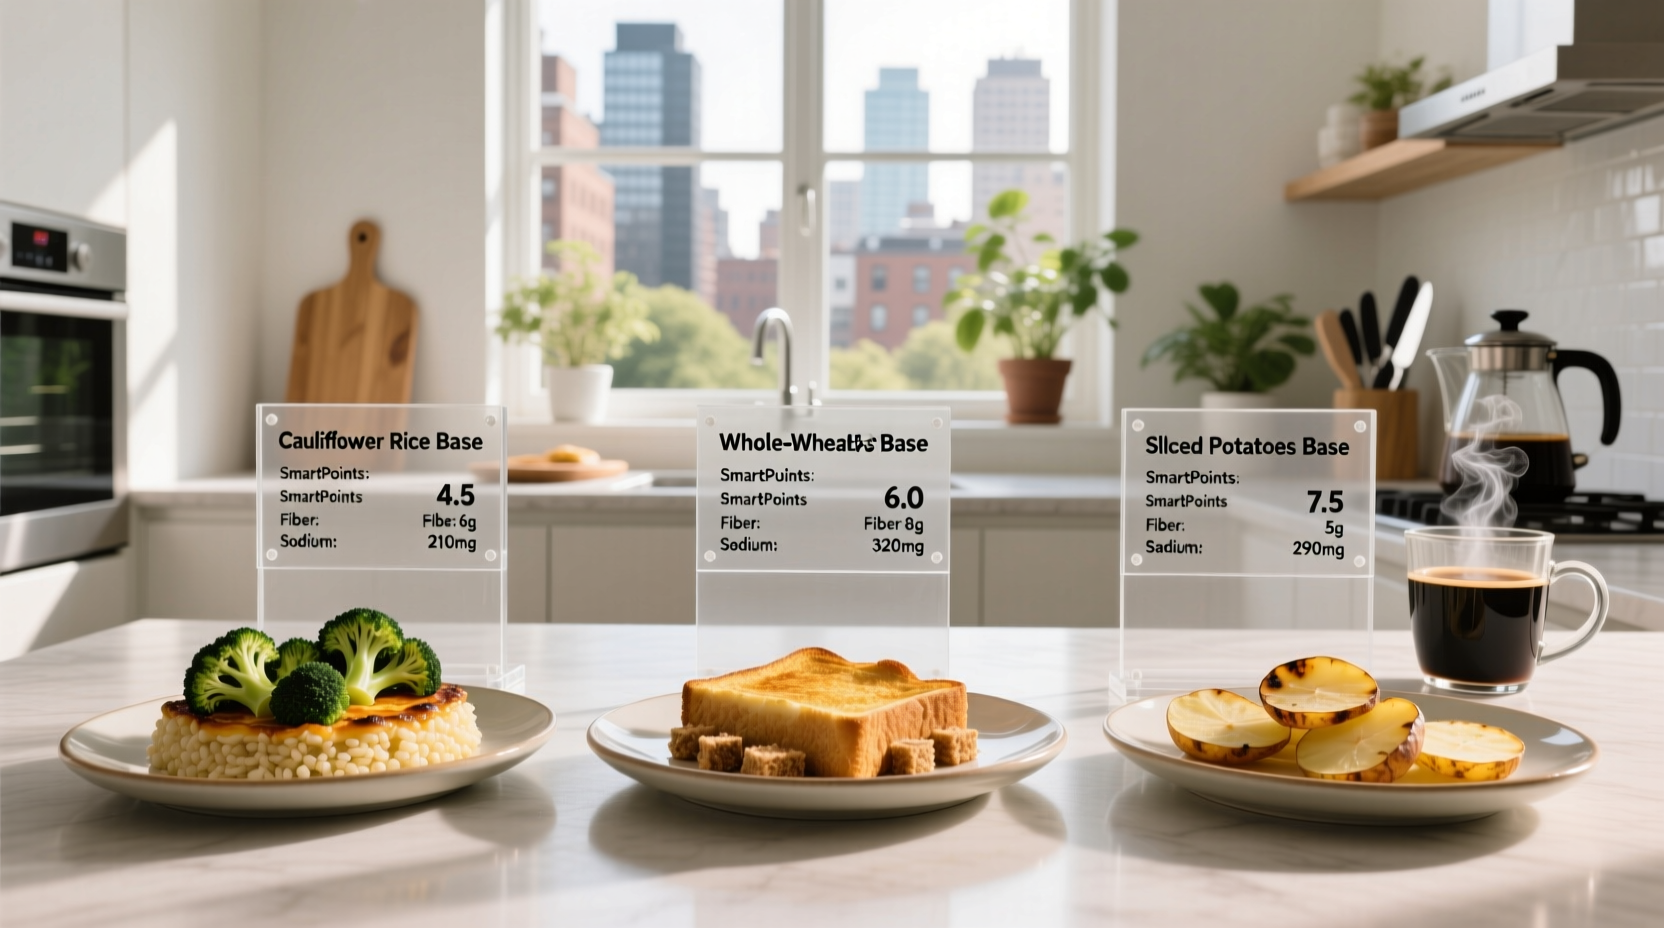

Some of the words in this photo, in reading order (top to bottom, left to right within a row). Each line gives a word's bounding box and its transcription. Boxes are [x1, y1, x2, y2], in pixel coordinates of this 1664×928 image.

[390, 431, 430, 450] Rice
[436, 432, 484, 451] Base
[881, 433, 929, 452] Base
[1210, 436, 1297, 456] Potatoes
[1303, 437, 1350, 456] Base
[280, 466, 370, 480] SmartPoints:
[1146, 470, 1240, 485] SmartPoints:
[280, 489, 363, 504] SmartPoints
[436, 483, 475, 507] 4.5
[721, 492, 807, 506] SmartPoints
[884, 485, 924, 510] 6.0
[1146, 493, 1228, 508] SmartPoints
[1307, 489, 1344, 514] 7.5
[280, 512, 319, 527] Fiber:
[459, 514, 477, 533] 6g
[721, 515, 761, 530] Fiber:
[864, 516, 901, 531] Fiber
[905, 517, 924, 536] 8g
[1324, 520, 1344, 539] 5g
[280, 533, 337, 549] Sodium:
[427, 534, 477, 553] 210mg
[872, 538, 925, 557] 320mg
[1292, 541, 1345, 561] 290mg
